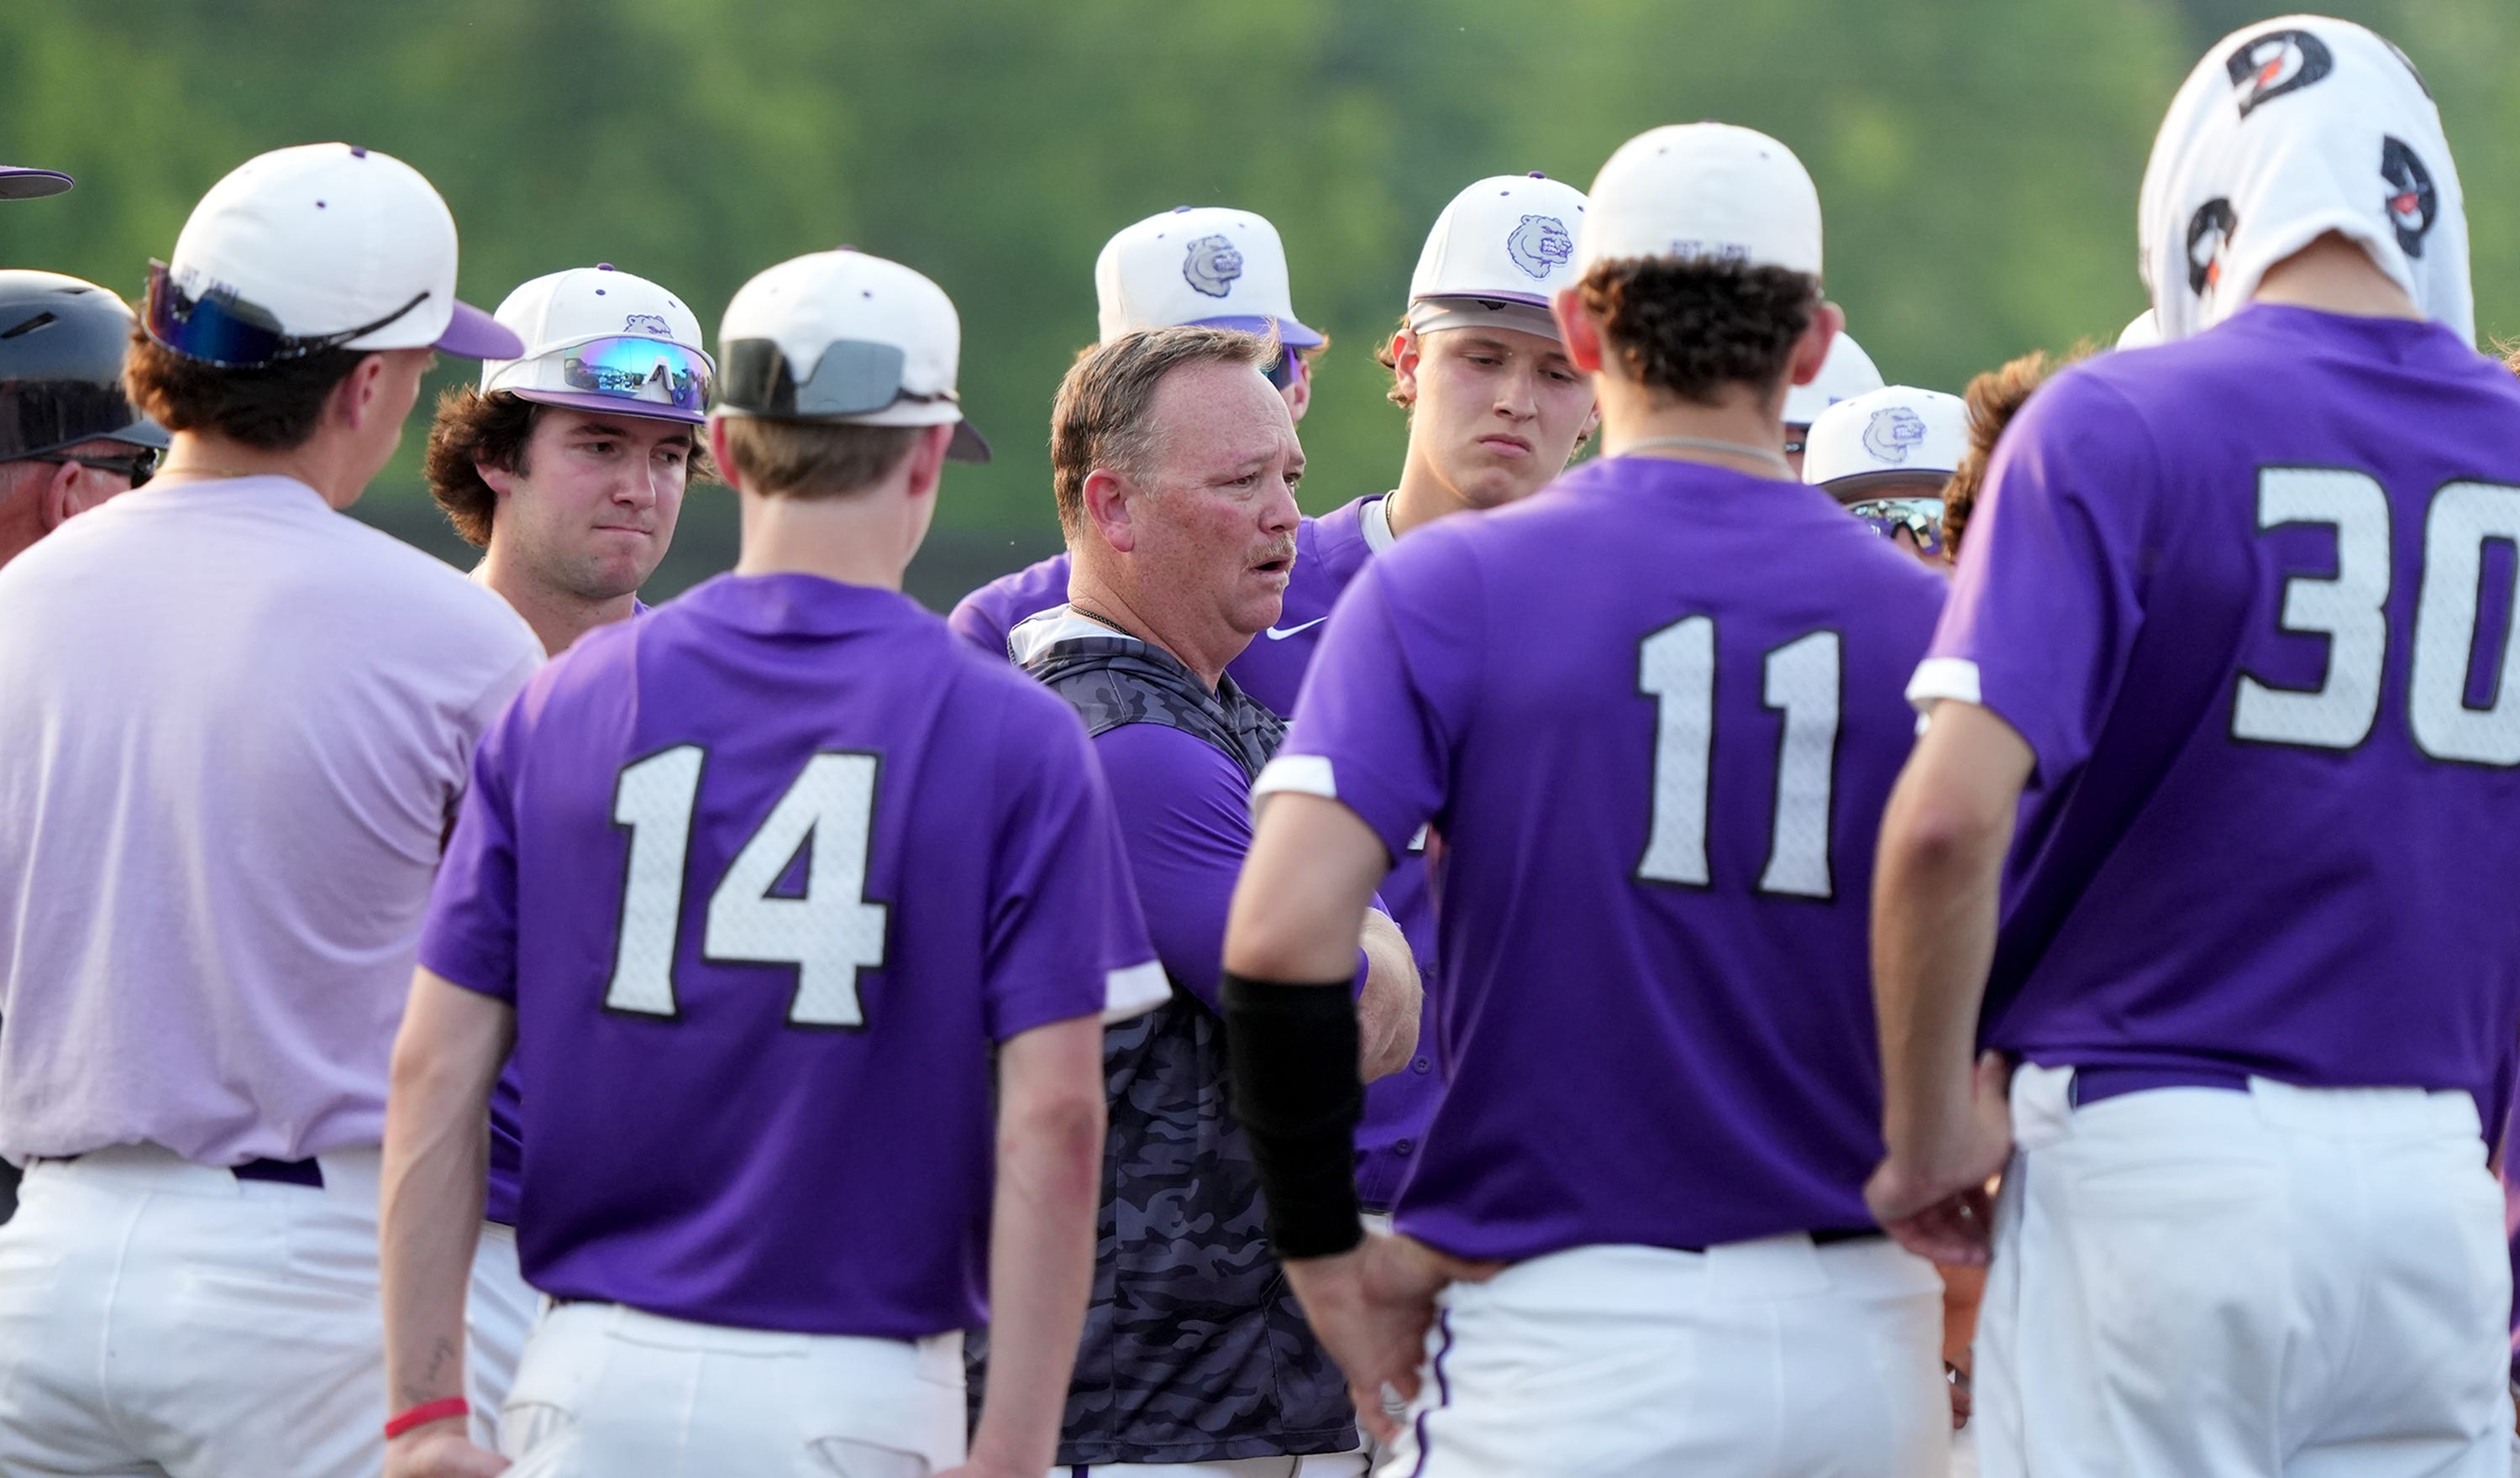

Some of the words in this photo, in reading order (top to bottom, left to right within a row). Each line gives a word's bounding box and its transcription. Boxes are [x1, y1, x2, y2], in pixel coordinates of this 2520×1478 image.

[1632, 612, 1843, 902] 11
[2228, 463, 2520, 768] 30
[601, 742, 892, 1030] 14
